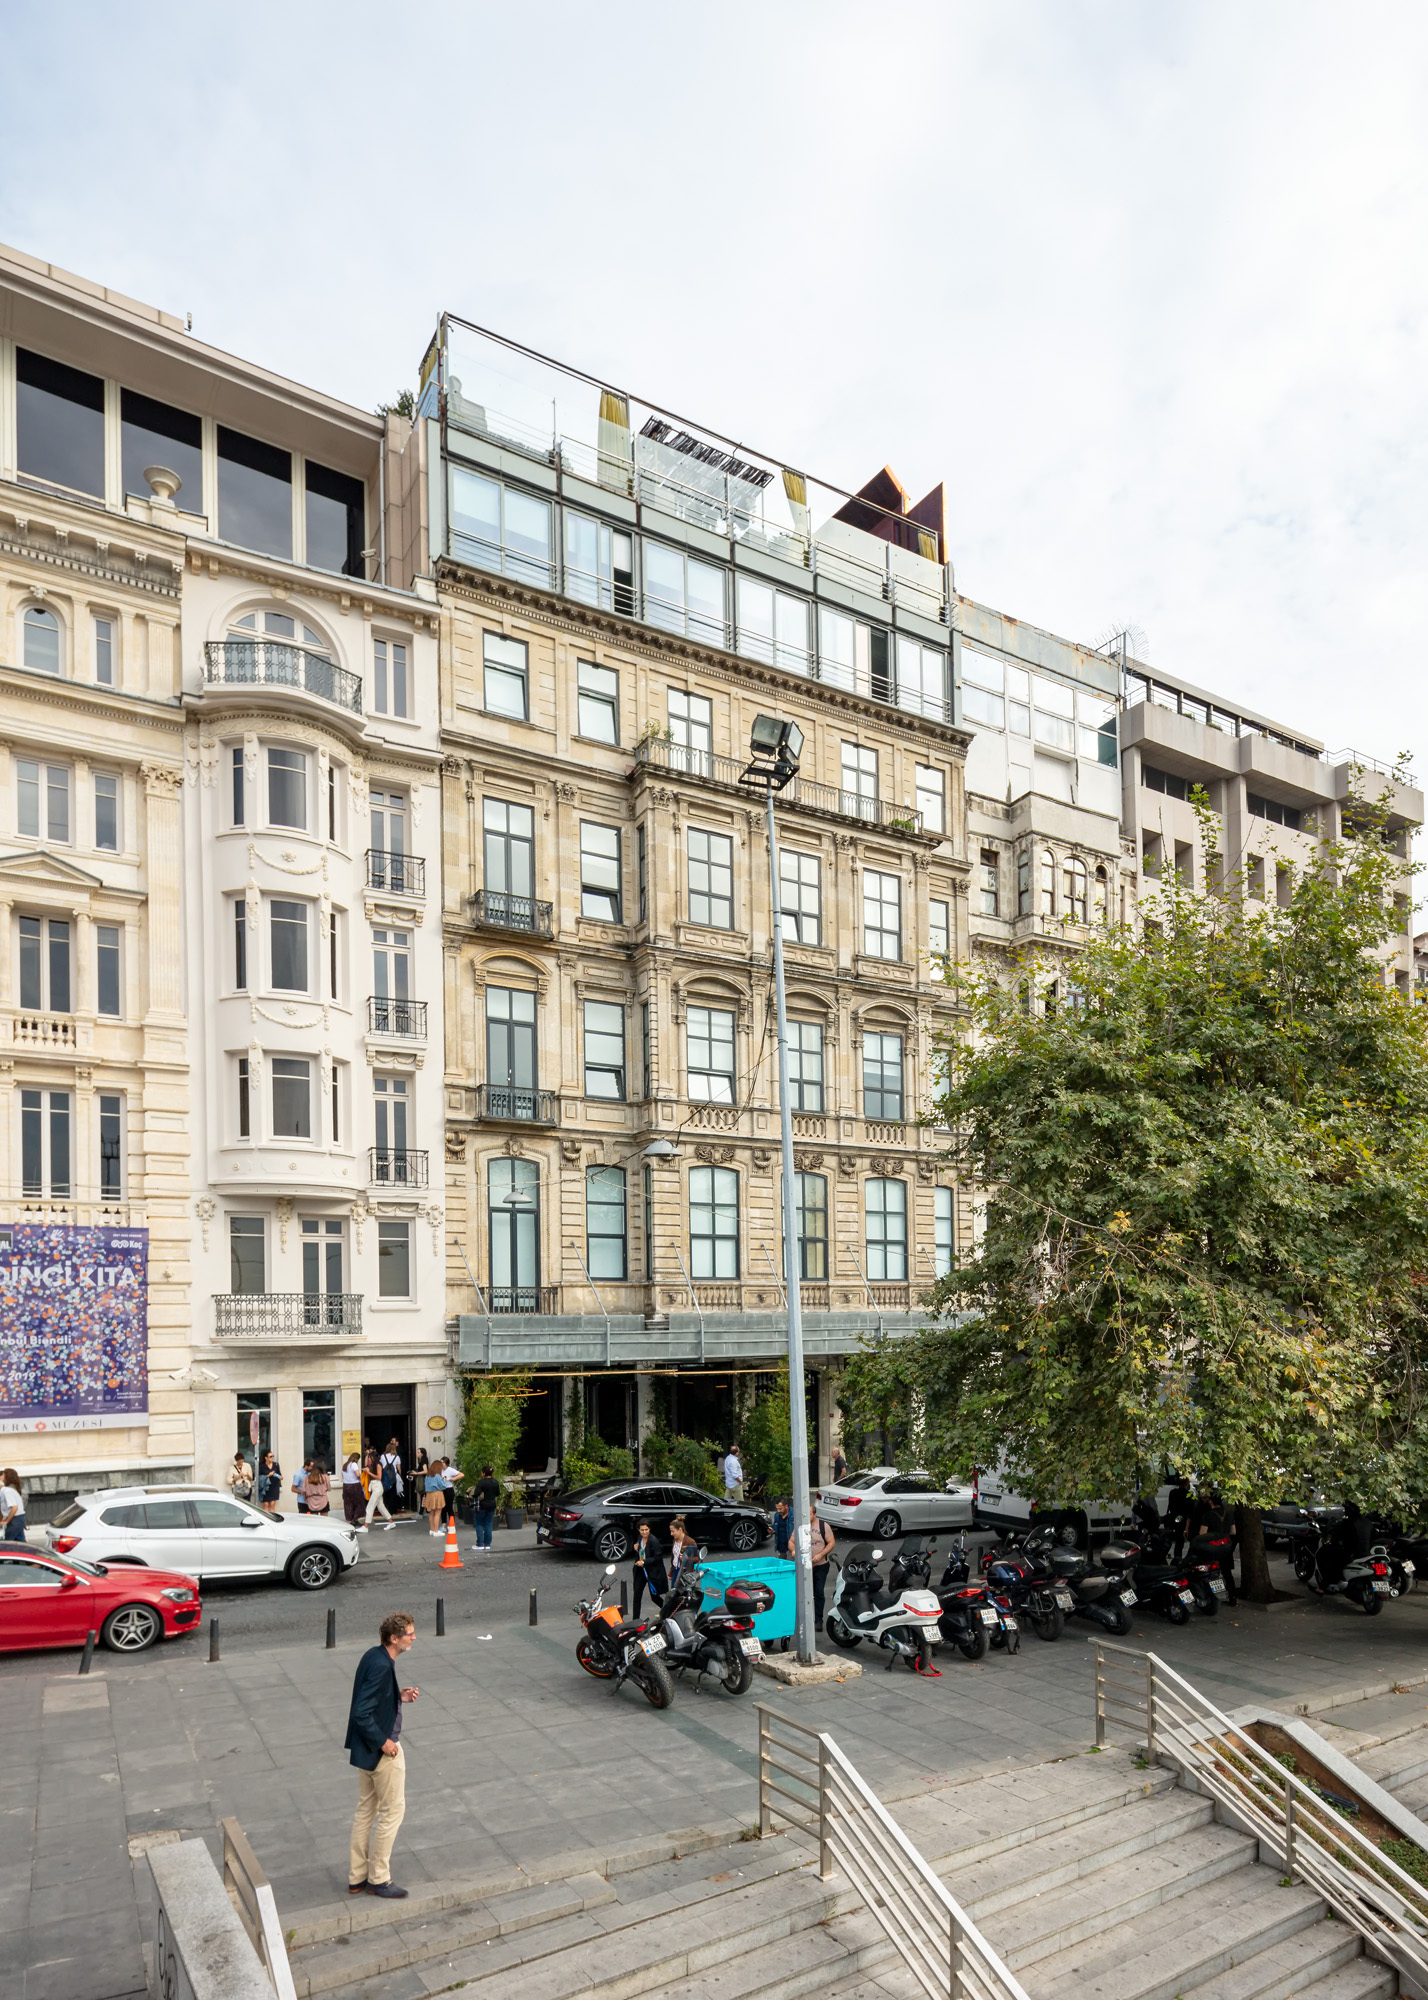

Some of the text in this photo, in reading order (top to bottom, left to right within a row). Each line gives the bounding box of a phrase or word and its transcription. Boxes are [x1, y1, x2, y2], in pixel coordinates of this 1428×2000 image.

[129, 1240, 143, 1250] Koç
[79, 1266, 139, 1288] KITA
[644, 1634, 661, 1649] 34 ZP
[649, 1641, 664, 1652] 4108
